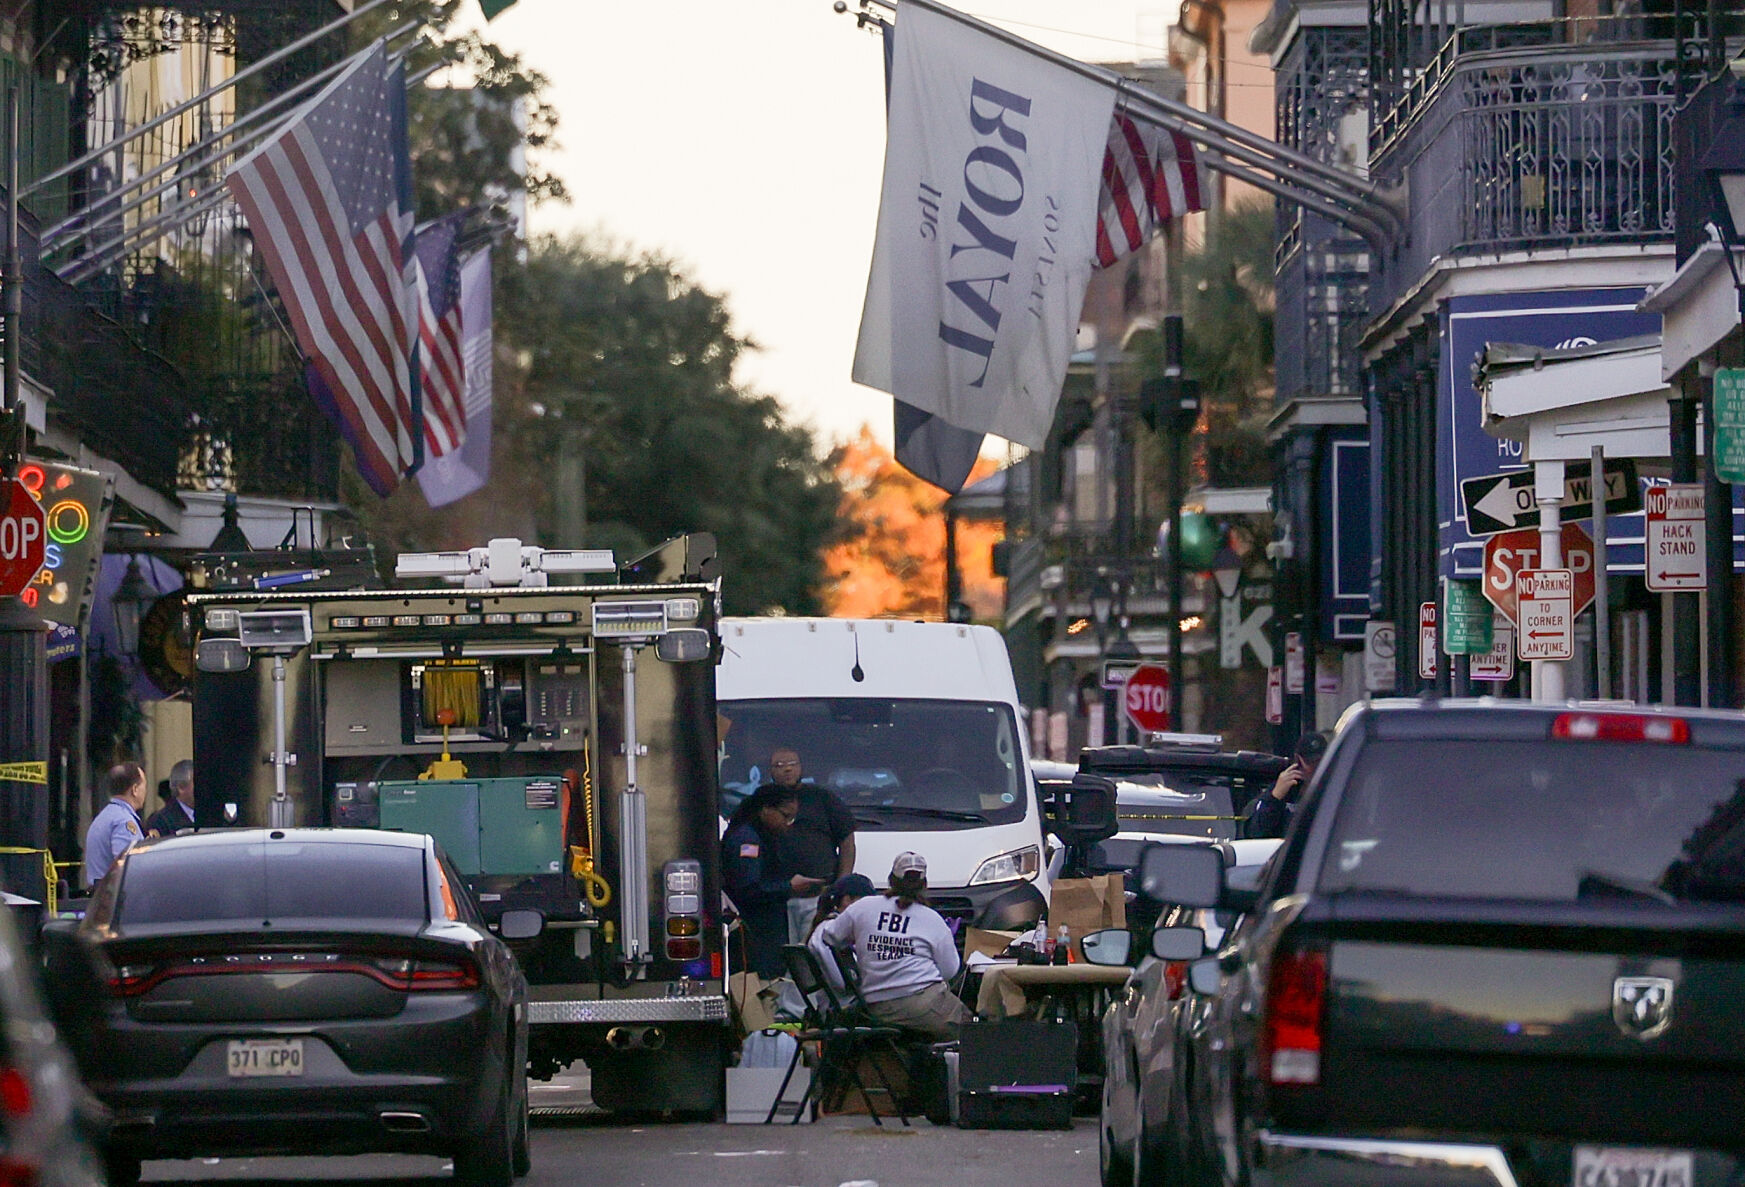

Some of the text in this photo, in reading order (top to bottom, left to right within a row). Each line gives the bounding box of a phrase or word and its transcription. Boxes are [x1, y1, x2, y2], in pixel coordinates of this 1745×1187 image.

[1570, 476, 1618, 501] WY
[1648, 494, 1666, 514] NO
[1663, 525, 1692, 538] HACK
[1660, 542, 1696, 555] STAND
[1491, 548, 1591, 590] STP
[1520, 578, 1570, 595] NO PARKING
[1540, 603, 1551, 613] TO
[1423, 608, 1436, 622] NO
[1527, 616, 1563, 627] CORNER
[1527, 642, 1564, 653] ANYTIME
[1471, 655, 1508, 665] ANYTIME
[877, 911, 910, 934] FBI
[869, 935, 914, 947] EVIDENCE
[867, 943, 916, 956] RESPONSE
[231, 1050, 258, 1068] 371
